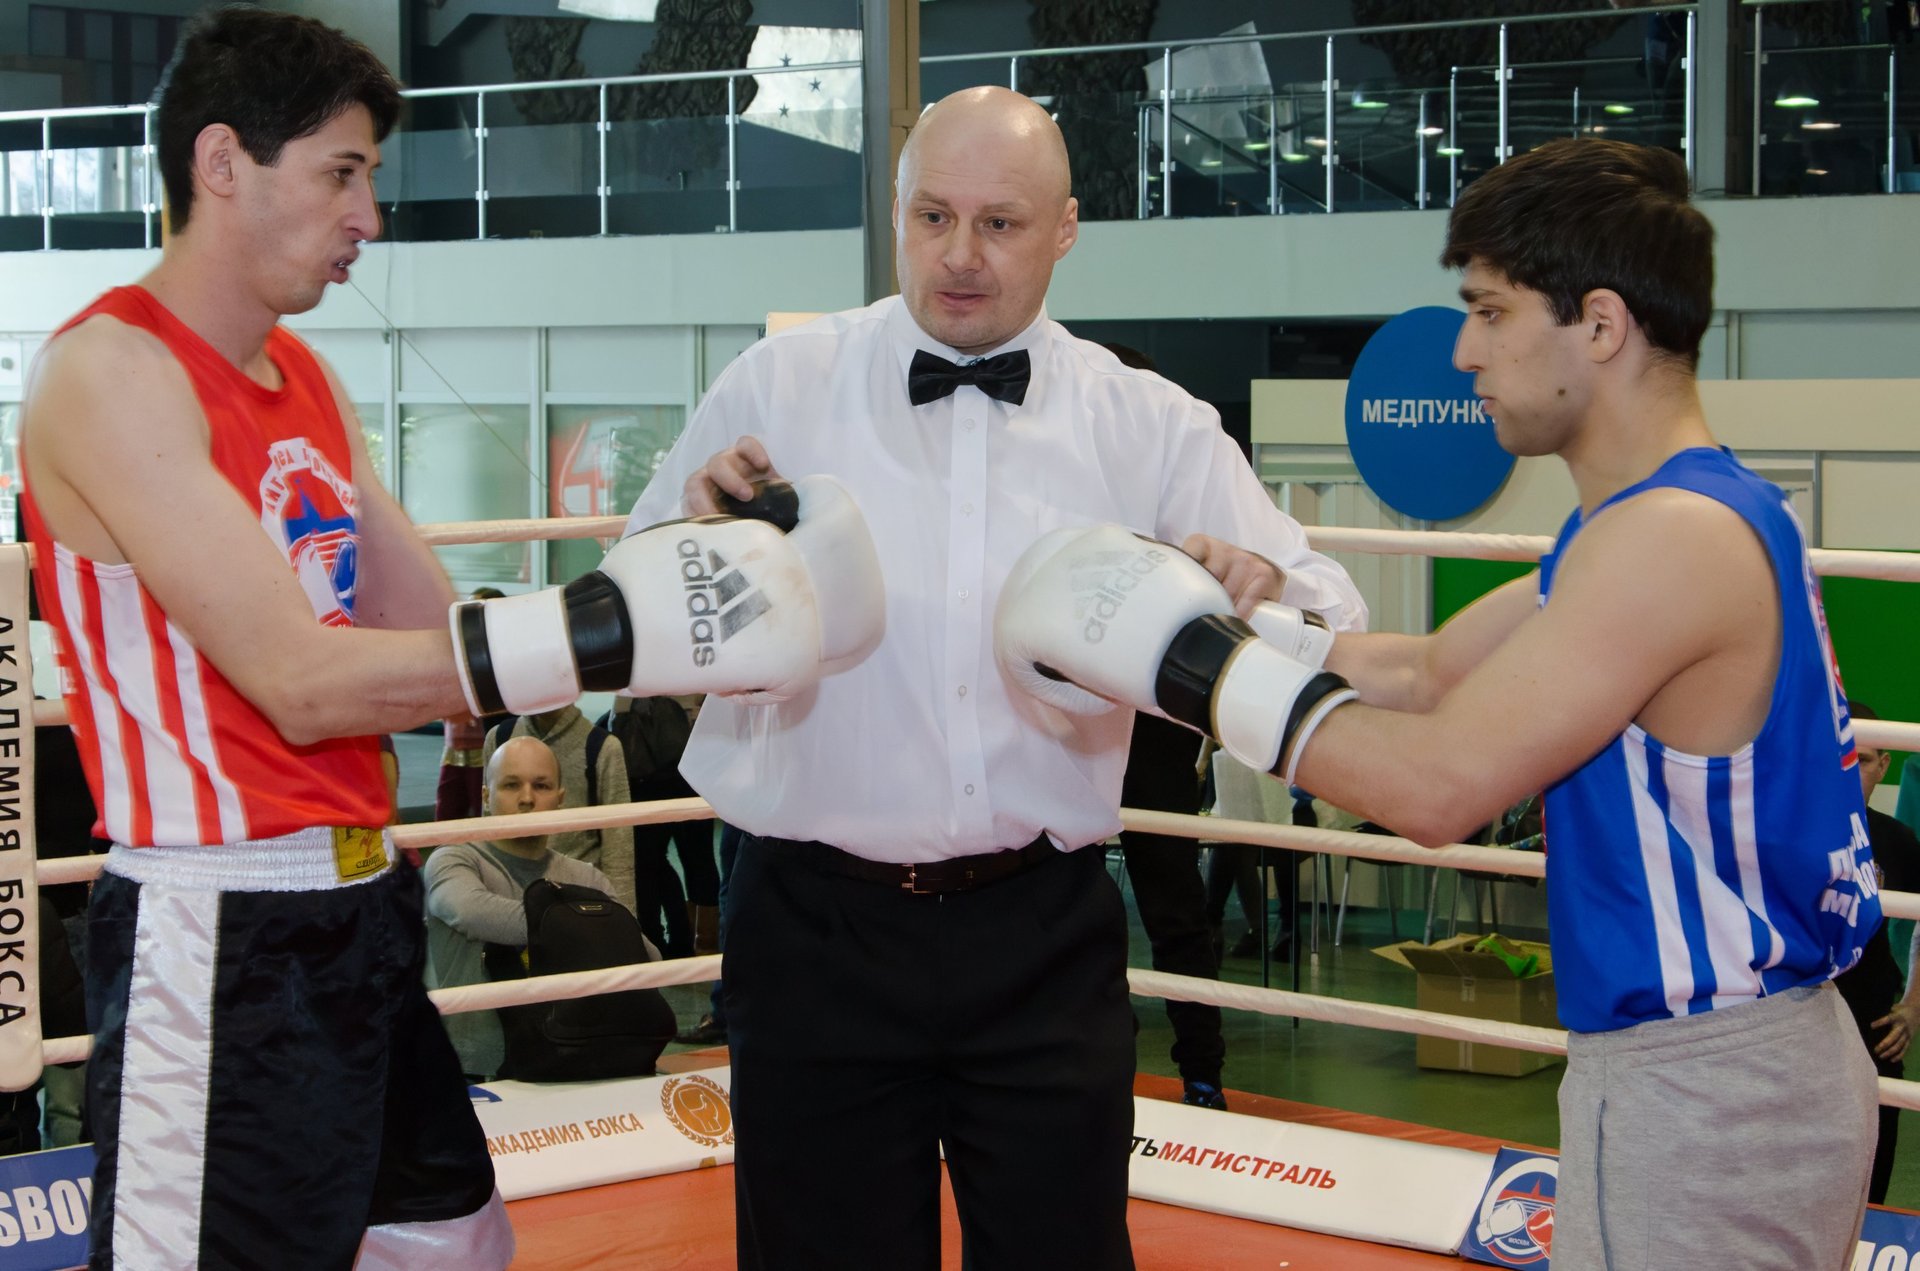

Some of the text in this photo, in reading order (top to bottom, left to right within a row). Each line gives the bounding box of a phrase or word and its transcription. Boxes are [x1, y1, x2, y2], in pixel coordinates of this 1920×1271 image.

[1362, 399, 1496, 428] МЕДПУНК
[677, 539, 720, 668] adidas
[1084, 550, 1168, 645] adidas
[0, 879, 26, 1027] БОКСА
[487, 1112, 644, 1157] АКАДЕМИЯ БОКСА
